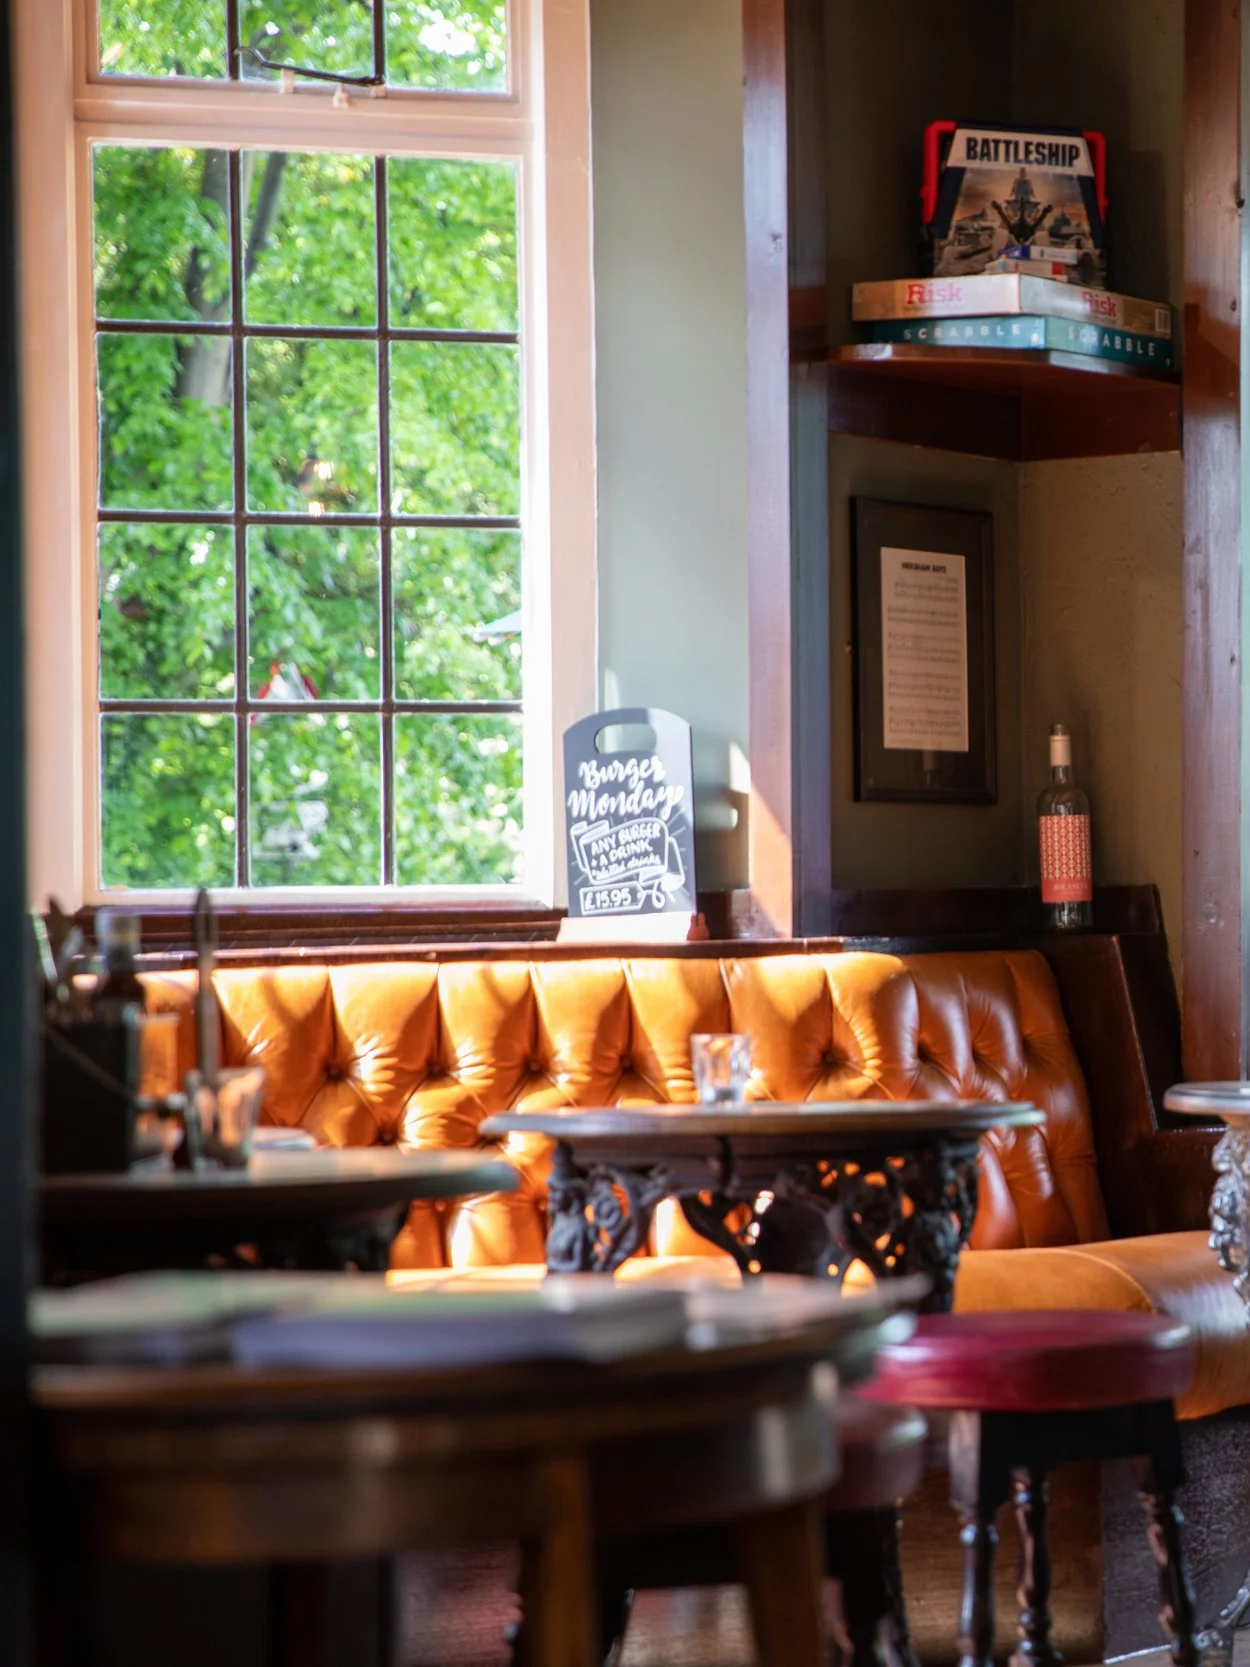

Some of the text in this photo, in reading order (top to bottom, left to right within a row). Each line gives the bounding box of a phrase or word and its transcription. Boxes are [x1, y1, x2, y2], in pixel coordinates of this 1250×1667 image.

[965, 136, 1081, 168] BATTLESHIP
[906, 283, 963, 306] Risk
[1081, 291, 1117, 318] Risk
[903, 323, 1021, 340] SCRABBLE
[1067, 325, 1155, 356] SCRABBLE
[579, 755, 667, 788] Burger
[591, 822, 661, 857] ANY BURGER
[609, 839, 654, 862] DRINK
[585, 888, 632, 910] £15.95
